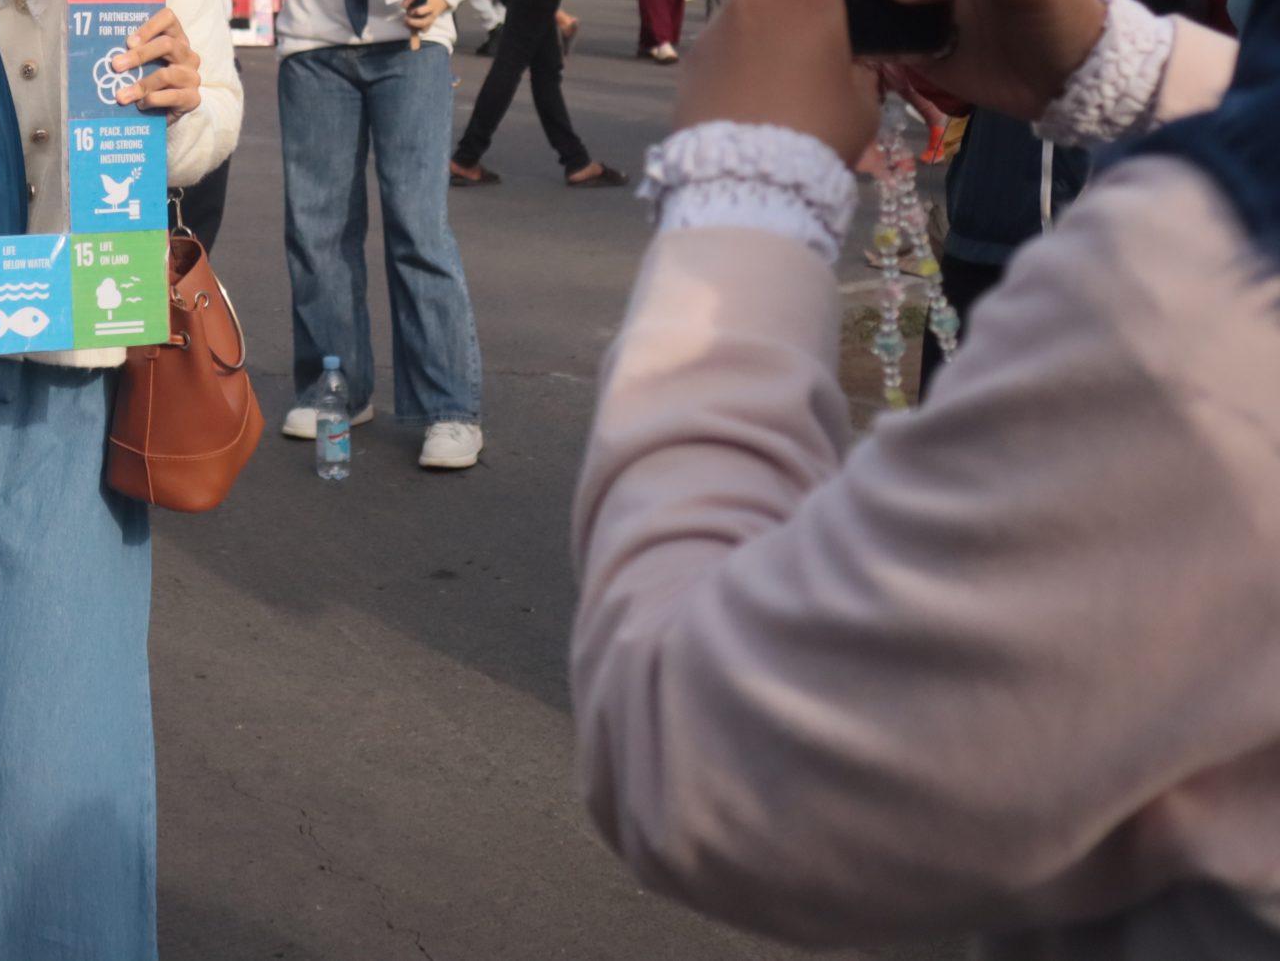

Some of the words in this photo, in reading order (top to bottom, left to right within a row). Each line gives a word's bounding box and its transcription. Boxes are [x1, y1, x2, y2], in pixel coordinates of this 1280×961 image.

[99, 12, 150, 23] PARTNERSHIPS
[73, 11, 93, 36] 17
[99, 25, 113, 36] FOR
[114, 25, 126, 36] THE
[124, 125, 151, 136] JUSTICE
[74, 127, 94, 152] 16
[100, 140, 114, 150] AND
[116, 139, 143, 150] STRONG
[100, 153, 146, 164] INSTITUTIONS
[2, 245, 17, 256] LIFE
[99, 241, 113, 252] LIFE
[74, 242, 94, 267] 15
[100, 255, 110, 265] ON
[111, 254, 129, 265] LAND
[3, 259, 26, 270] BELOW
[27, 257, 52, 269] WATER
